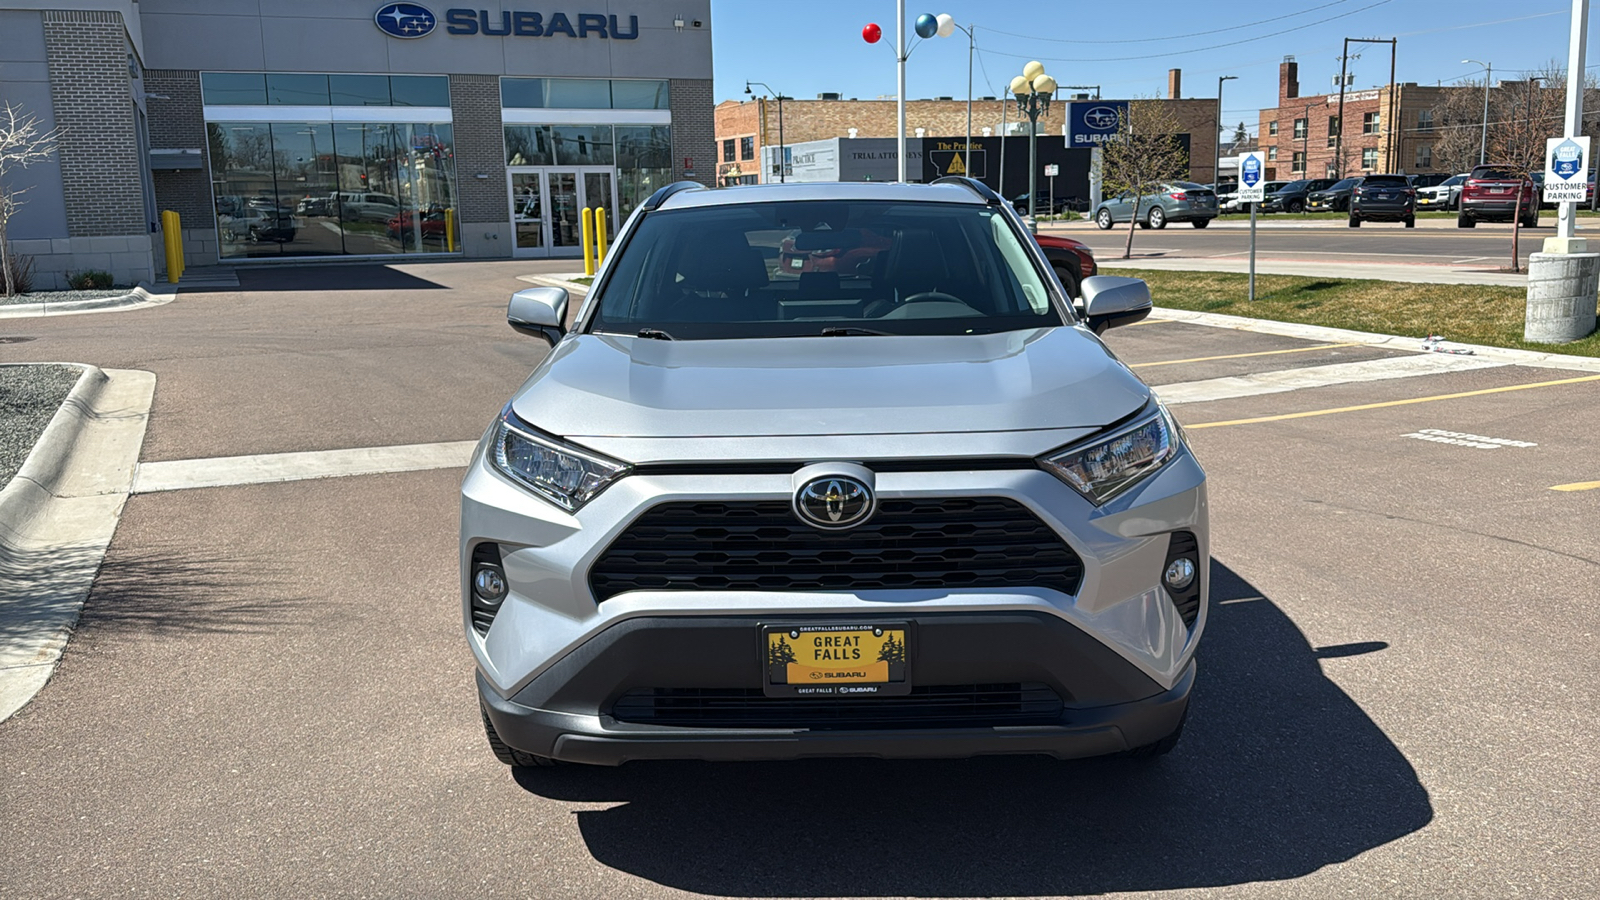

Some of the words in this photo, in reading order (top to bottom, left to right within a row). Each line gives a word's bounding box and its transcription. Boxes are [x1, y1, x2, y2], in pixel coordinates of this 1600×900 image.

[446, 8, 639, 40] SUBARU
[937, 142, 952, 150] The
[953, 142, 983, 150] Pratice
[852, 152, 877, 160] TRIAL
[878, 151, 923, 160] ATTOEYS
[1544, 183, 1587, 191] CUSTOMER
[1547, 192, 1582, 200] PARKING
[814, 636, 860, 647] GREAT
[814, 648, 861, 660] FALLS
